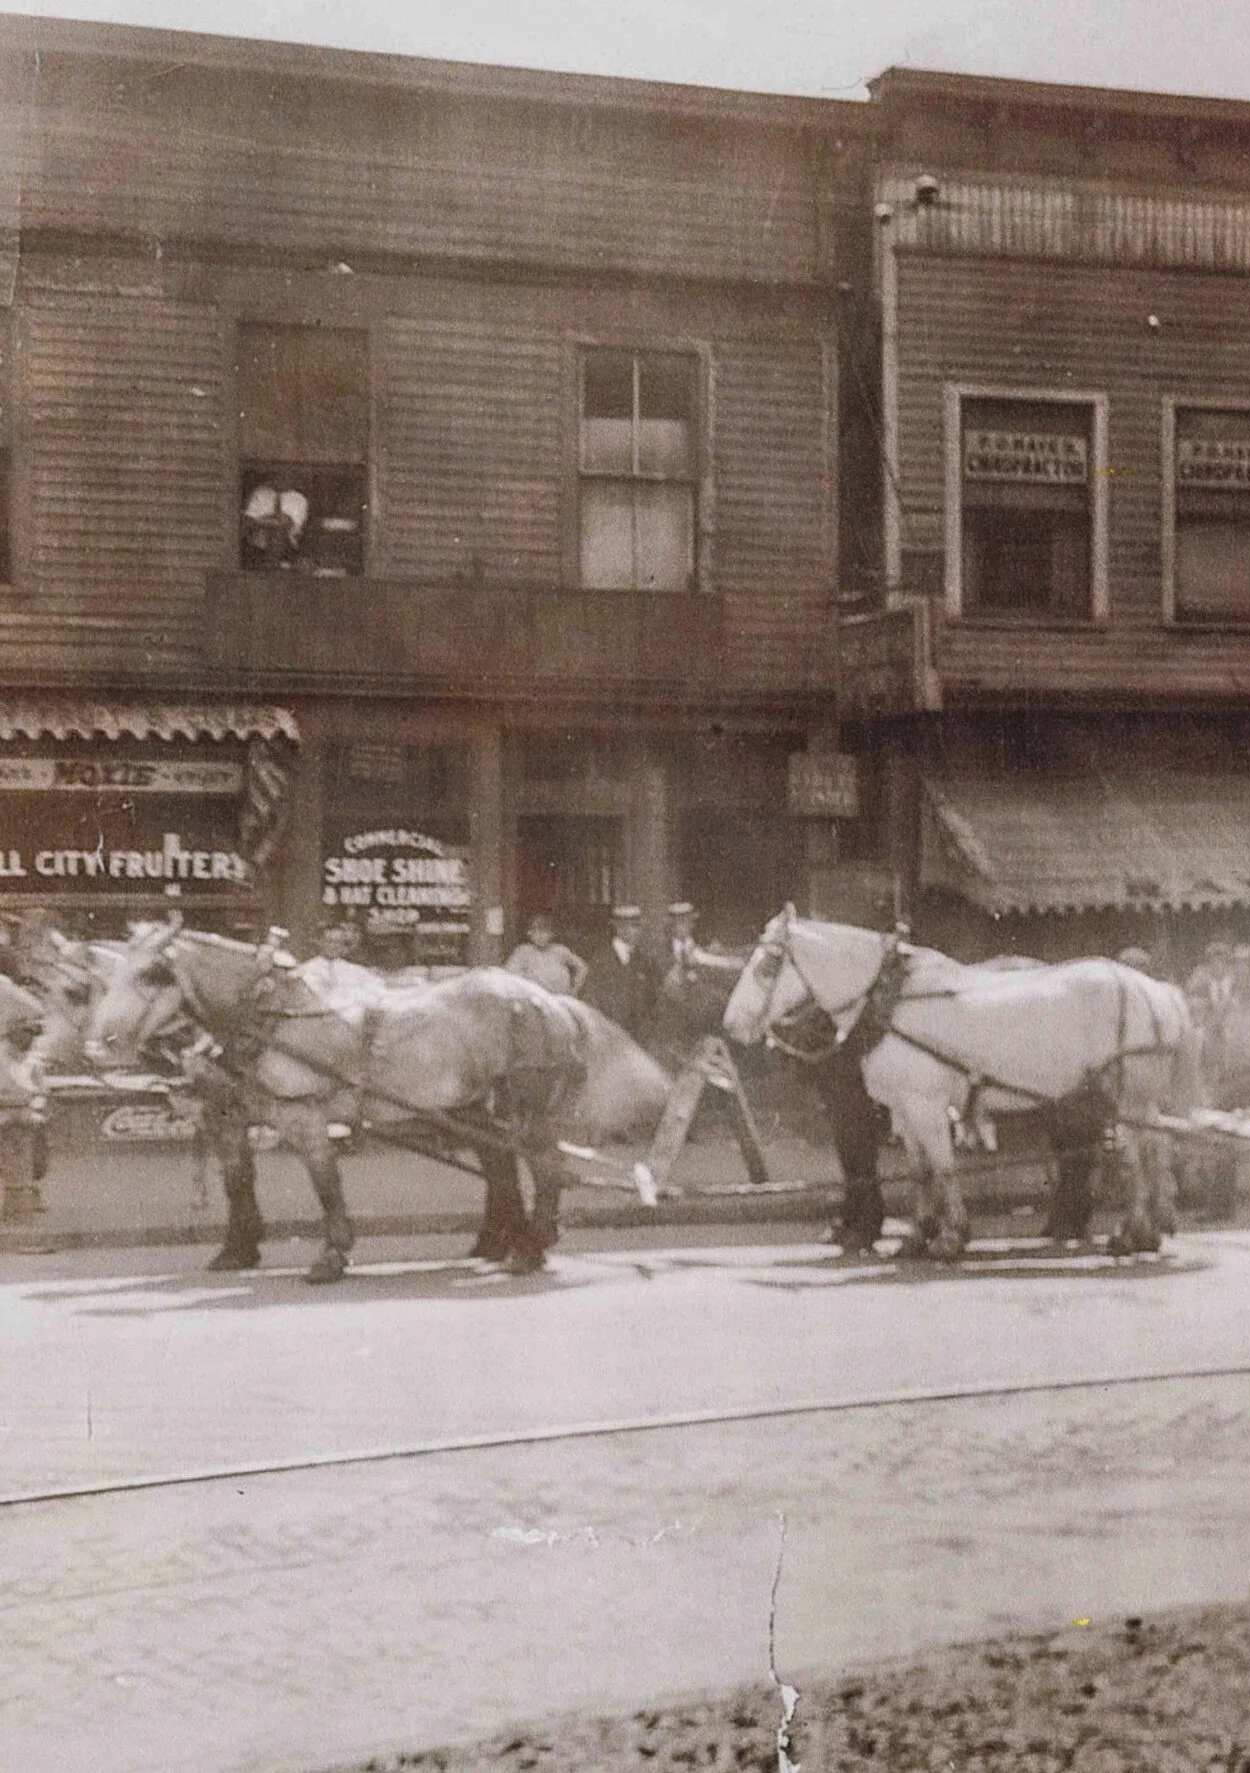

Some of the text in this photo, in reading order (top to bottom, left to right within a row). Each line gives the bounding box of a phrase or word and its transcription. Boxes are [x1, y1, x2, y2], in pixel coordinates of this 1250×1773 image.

[35, 850, 104, 877] CITY
[324, 857, 467, 885] SHOE SHINE
